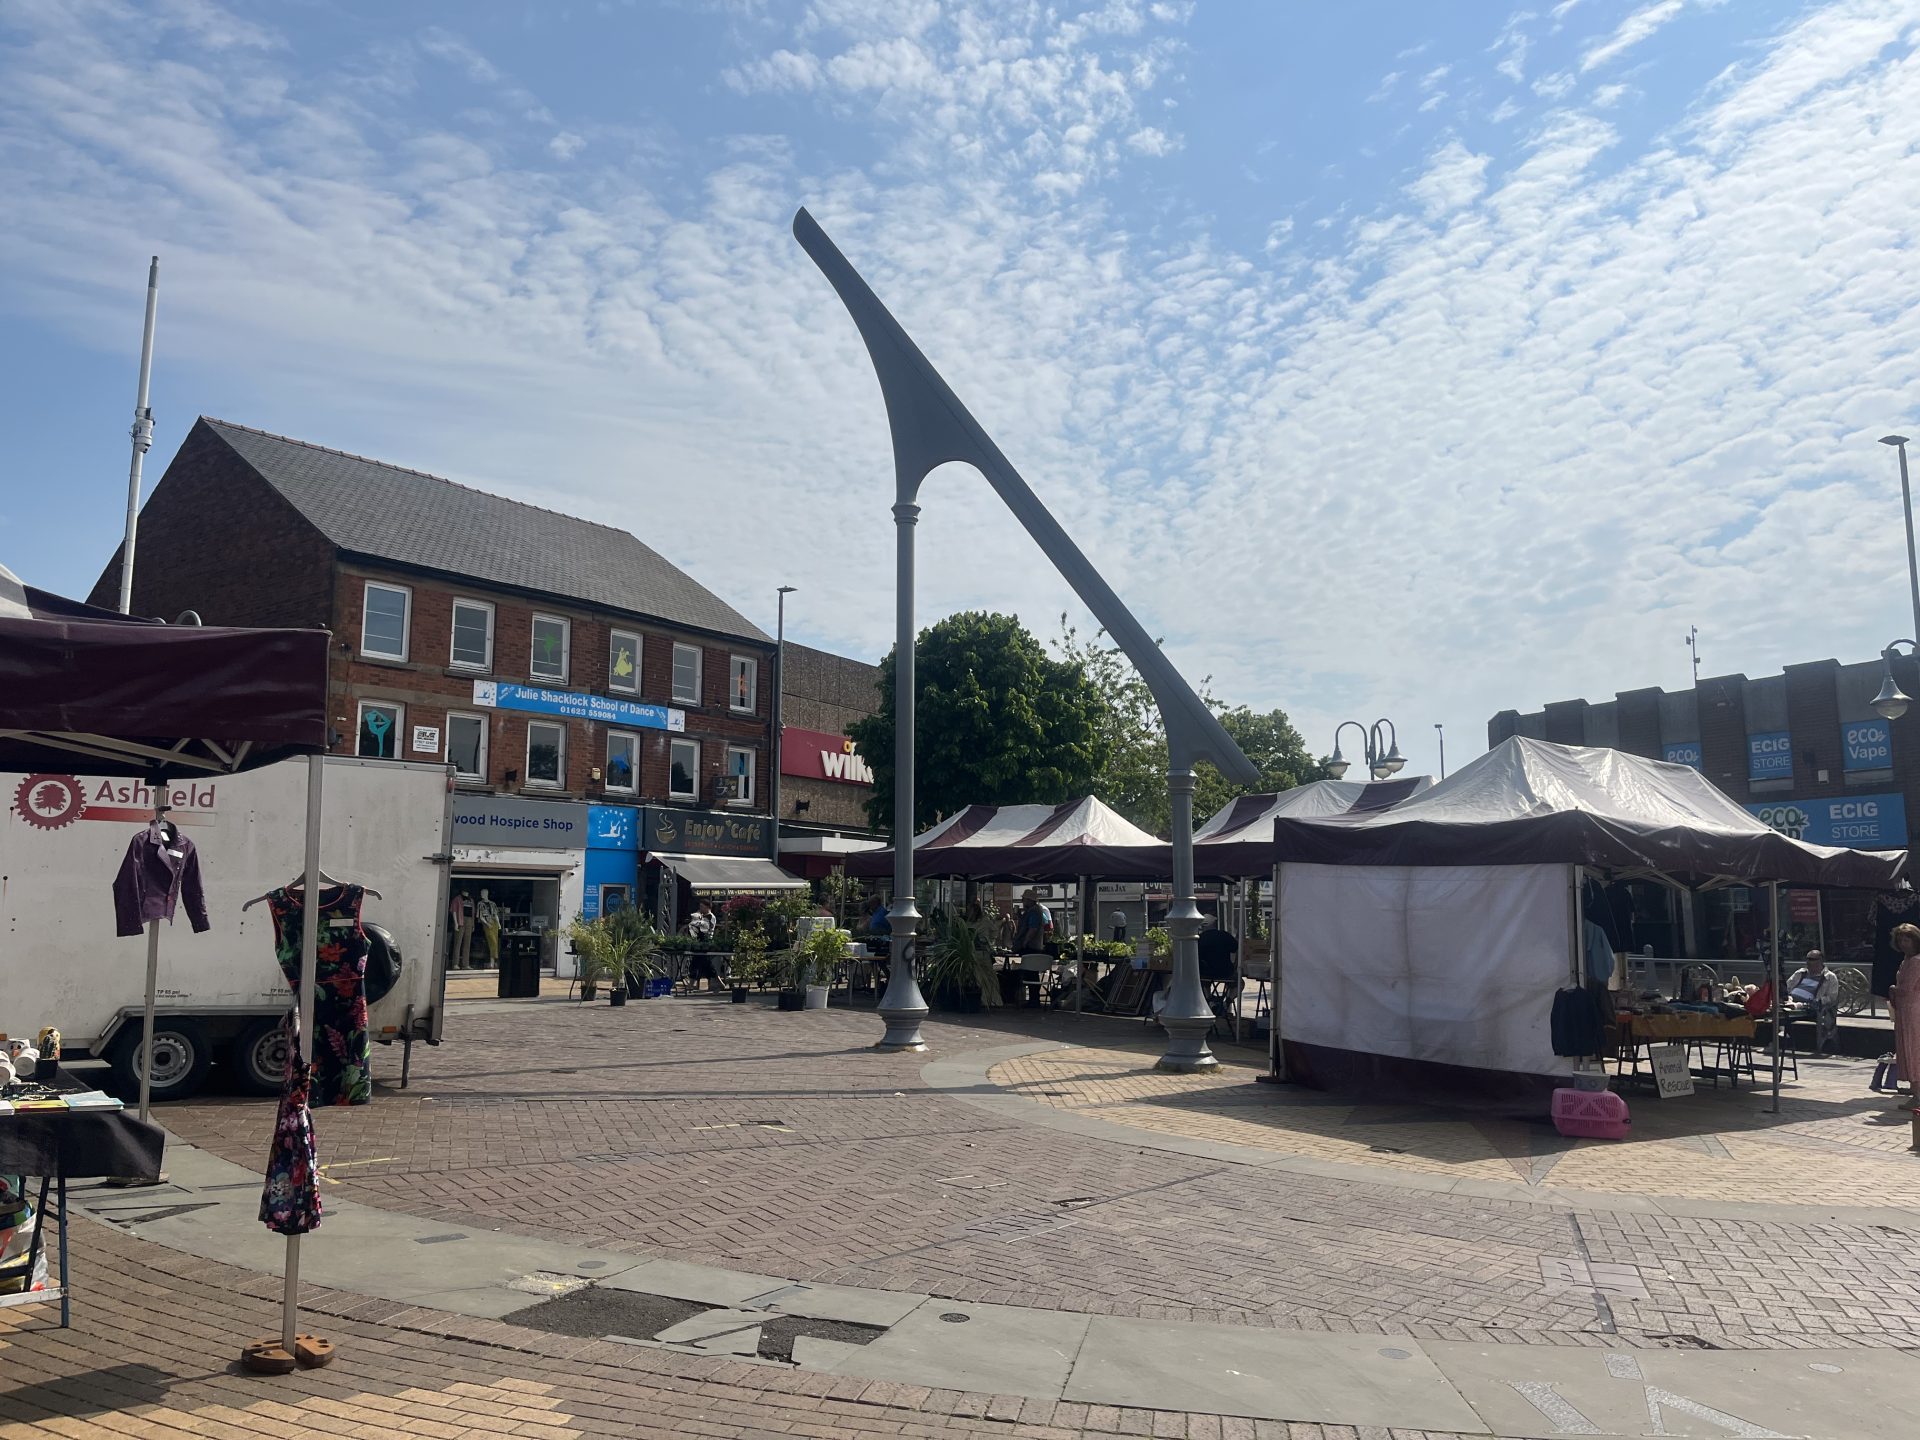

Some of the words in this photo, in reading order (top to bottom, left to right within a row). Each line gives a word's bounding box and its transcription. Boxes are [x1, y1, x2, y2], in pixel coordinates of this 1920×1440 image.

[515, 688, 539, 700] Julie
[541, 689, 588, 707] Shacklock
[590, 698, 618, 711] School
[620, 701, 628, 713] of
[630, 703, 655, 717] Dance
[560, 706, 586, 717] 01623
[1752, 738, 1790, 754] ECIG
[1848, 746, 1888, 761] Vape
[821, 740, 874, 784] wilk
[1753, 756, 1791, 770] STORE
[95, 779, 216, 808] Ashield
[1829, 802, 1878, 820] ECIG
[490, 815, 539, 829] Hospice
[543, 818, 573, 832] Shop
[684, 819, 725, 841] Enjoy
[730, 823, 761, 843] Café
[1831, 824, 1880, 839] STORE
